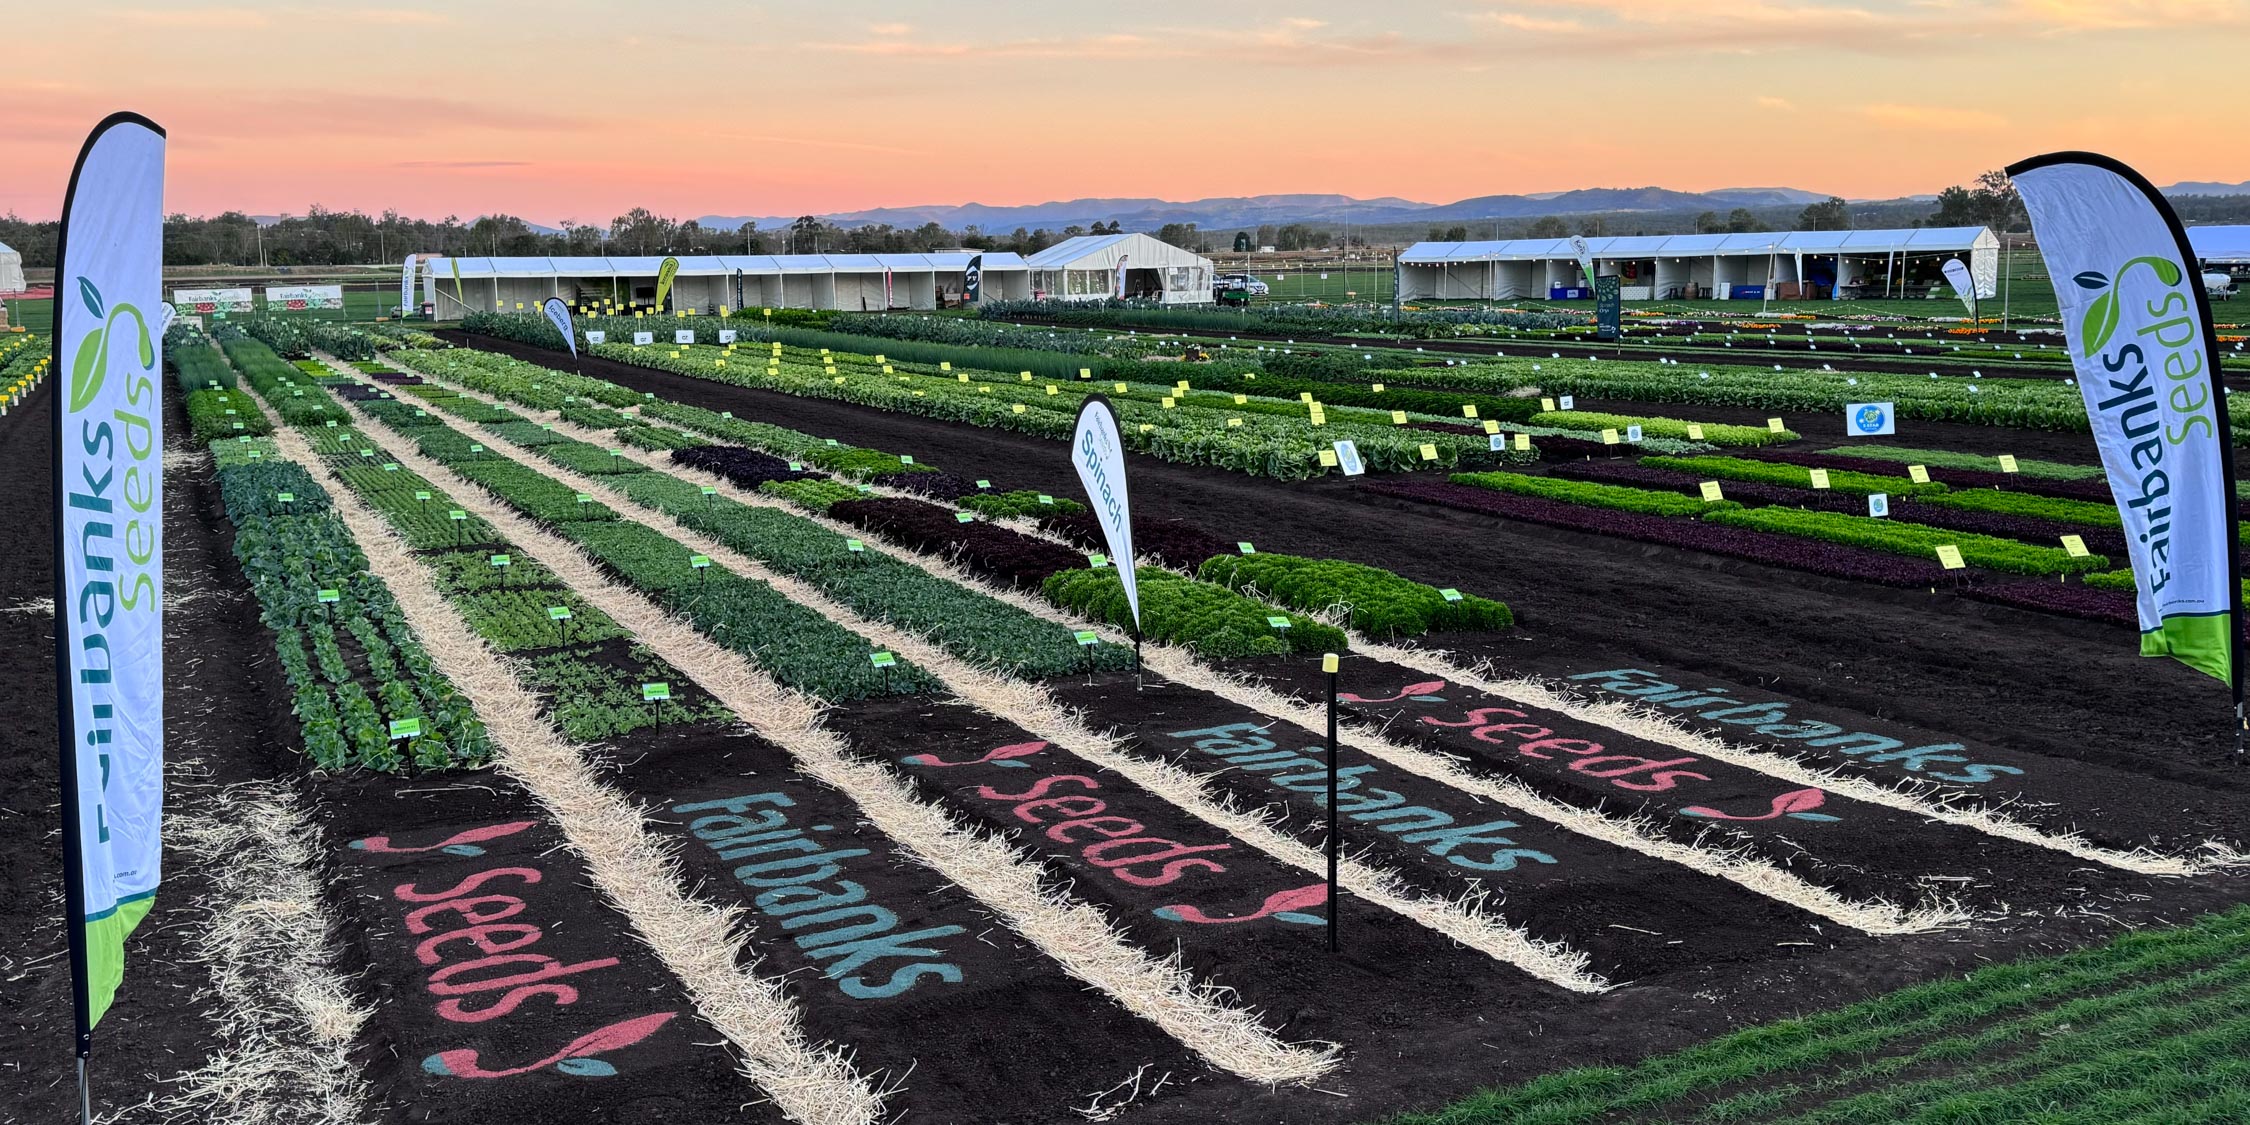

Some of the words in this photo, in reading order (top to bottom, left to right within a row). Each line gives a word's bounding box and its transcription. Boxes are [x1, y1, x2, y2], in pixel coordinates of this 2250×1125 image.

[548, 304, 569, 331] Iceberg
[2136, 291, 2212, 447] Seeds
[113, 372, 156, 613] Seeds
[1082, 429, 1122, 533] Spinach
[2098, 343, 2172, 596] Fairbanks
[69, 418, 114, 844] irbanks
[1166, 722, 1559, 871] Fairbanks
[1420, 707, 1711, 791] Seeds
[1568, 668, 2024, 782] Fairbanks
[671, 792, 967, 999] Fairbanks
[977, 775, 1232, 886] Seeds
[394, 867, 621, 1023] Seeds
